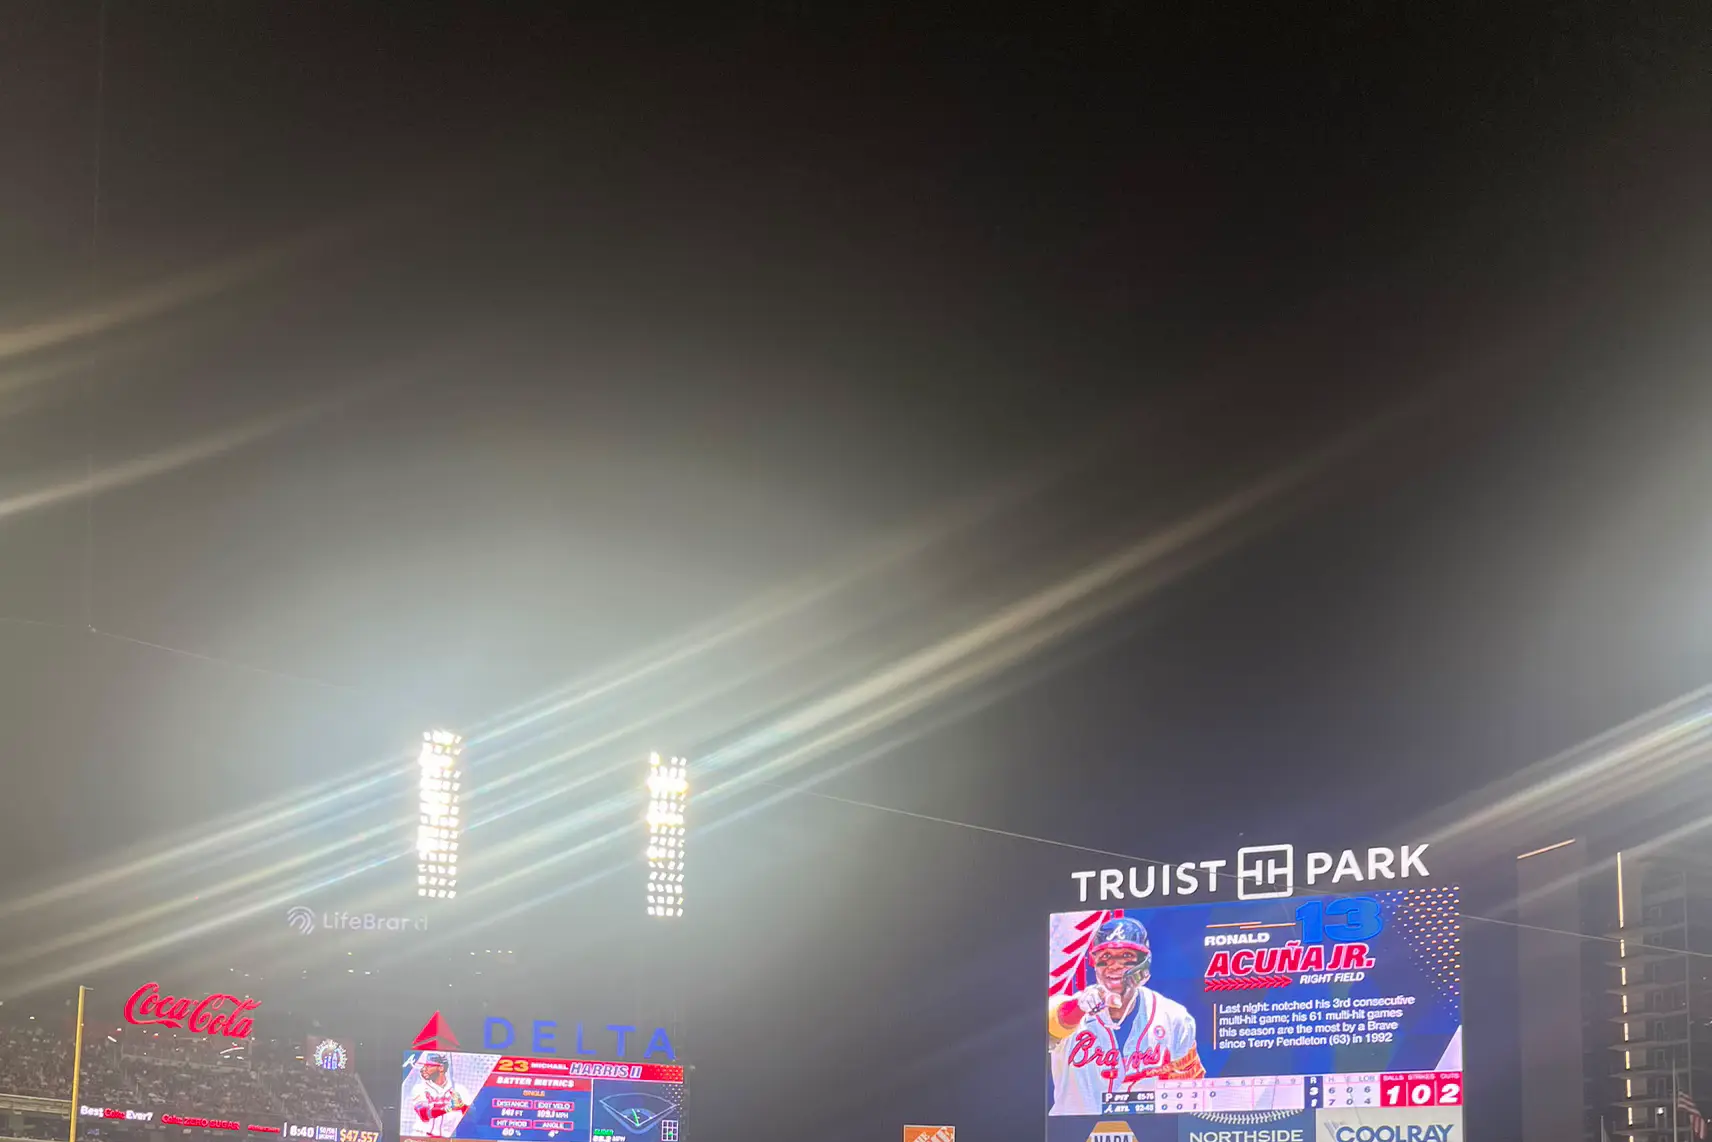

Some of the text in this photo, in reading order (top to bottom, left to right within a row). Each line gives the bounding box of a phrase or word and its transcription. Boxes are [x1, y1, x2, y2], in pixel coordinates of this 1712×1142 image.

[1071, 843, 1430, 902] TRUIST PARK
[1295, 897, 1384, 943] 13
[1204, 932, 1270, 946] RONALD
[1204, 940, 1376, 978] ACUÑA JR.
[1300, 972, 1365, 984] RIGHT FIELD
[123, 982, 262, 1039] Coca-Cola
[1219, 1003, 1241, 1014] Last
[1271, 999, 1313, 1012] notched
[1315, 998, 1330, 1009] his
[1332, 997, 1351, 1008] 3rd
[1353, 995, 1416, 1008] consecutive
[1219, 1014, 1257, 1025] multi-hit
[1291, 1011, 1307, 1022] his
[1309, 1011, 1322, 1022] 61
[1325, 1009, 1365, 1021] multi-hit
[1367, 1009, 1404, 1020] games
[483, 1016, 677, 1060] DELTA
[1219, 1020, 1399, 1037] this season are the most by a Brave
[1219, 1032, 1393, 1050] since Terry Pendleton (63) in 1992
[498, 1059, 529, 1072] 23
[570, 1062, 628, 1077] HARRIS
[496, 1076, 574, 1088] BATTER METRICS
[1387, 1083, 1460, 1105] 1 0 2
[80, 1105, 104, 1118] Best
[126, 1110, 153, 1121] Ever?
[183, 1116, 209, 1128] ZERO
[209, 1119, 240, 1131] SUGAR
